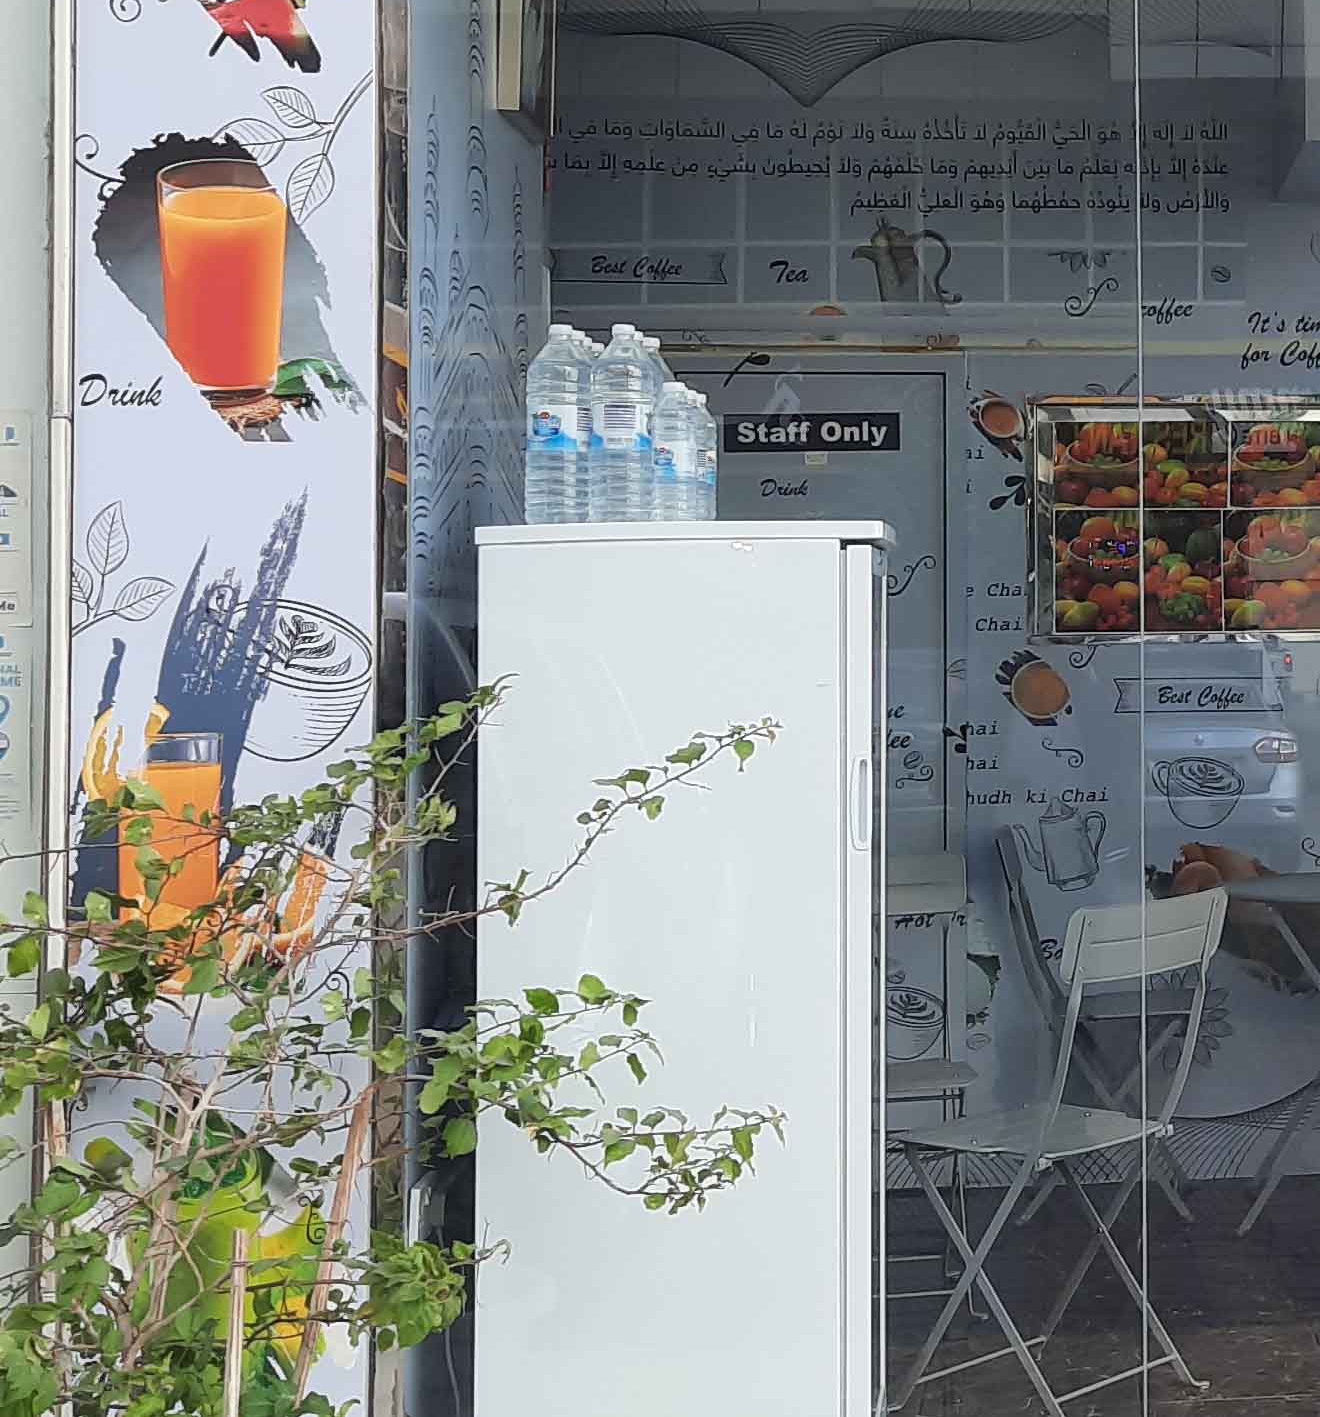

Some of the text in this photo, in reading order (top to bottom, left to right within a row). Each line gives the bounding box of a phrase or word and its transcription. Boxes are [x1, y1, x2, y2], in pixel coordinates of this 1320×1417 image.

[590, 255, 682, 279] Best Coffee
[768, 260, 809, 284] Tea
[1140, 296, 1194, 324] coffee
[1248, 311, 1285, 334] It's
[1240, 342, 1271, 369] for
[79, 374, 162, 408] Drink
[736, 420, 889, 448] Staff Only
[760, 478, 809, 497] Drink
[975, 616, 1022, 632] Chai
[1157, 684, 1245, 708] Best Coffee
[966, 721, 1000, 735] hai
[966, 757, 1000, 771] hai
[1026, 789, 1049, 804] ki
[1060, 786, 1110, 803] Chai
